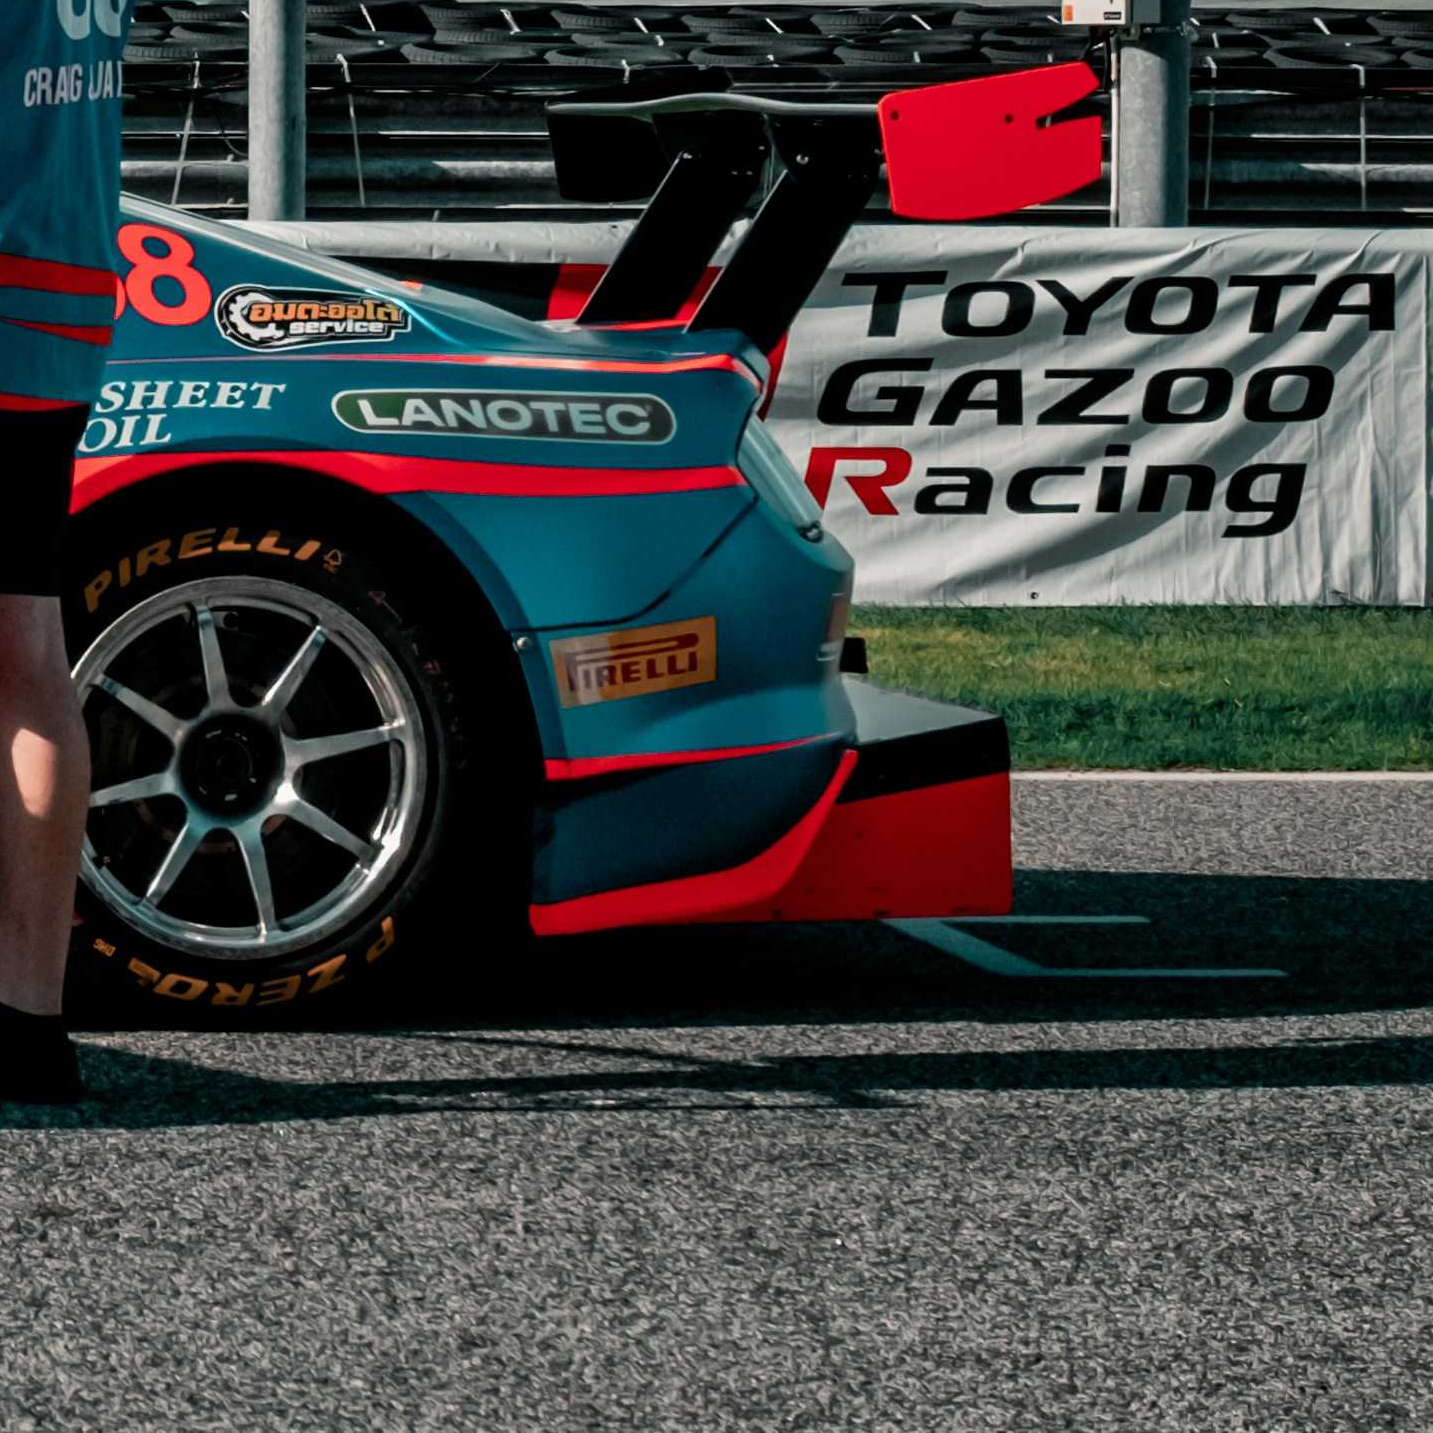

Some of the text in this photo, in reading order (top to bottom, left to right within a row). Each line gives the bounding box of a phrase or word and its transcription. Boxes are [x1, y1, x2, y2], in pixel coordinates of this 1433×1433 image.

[114, 224, 213, 326] 8
[840, 269, 1397, 338] TOYOTA
[289, 319, 384, 335] service
[94, 380, 286, 413] SHEET
[357, 397, 653, 436] LANOTEC
[816, 357, 1336, 427] GAZOO
[77, 414, 172, 453] OIL
[804, 442, 1308, 539] Racing
[83, 527, 322, 613] PIRELLI
[563, 632, 699, 692] PIRELLI
[152, 954, 348, 1007] ZERO
